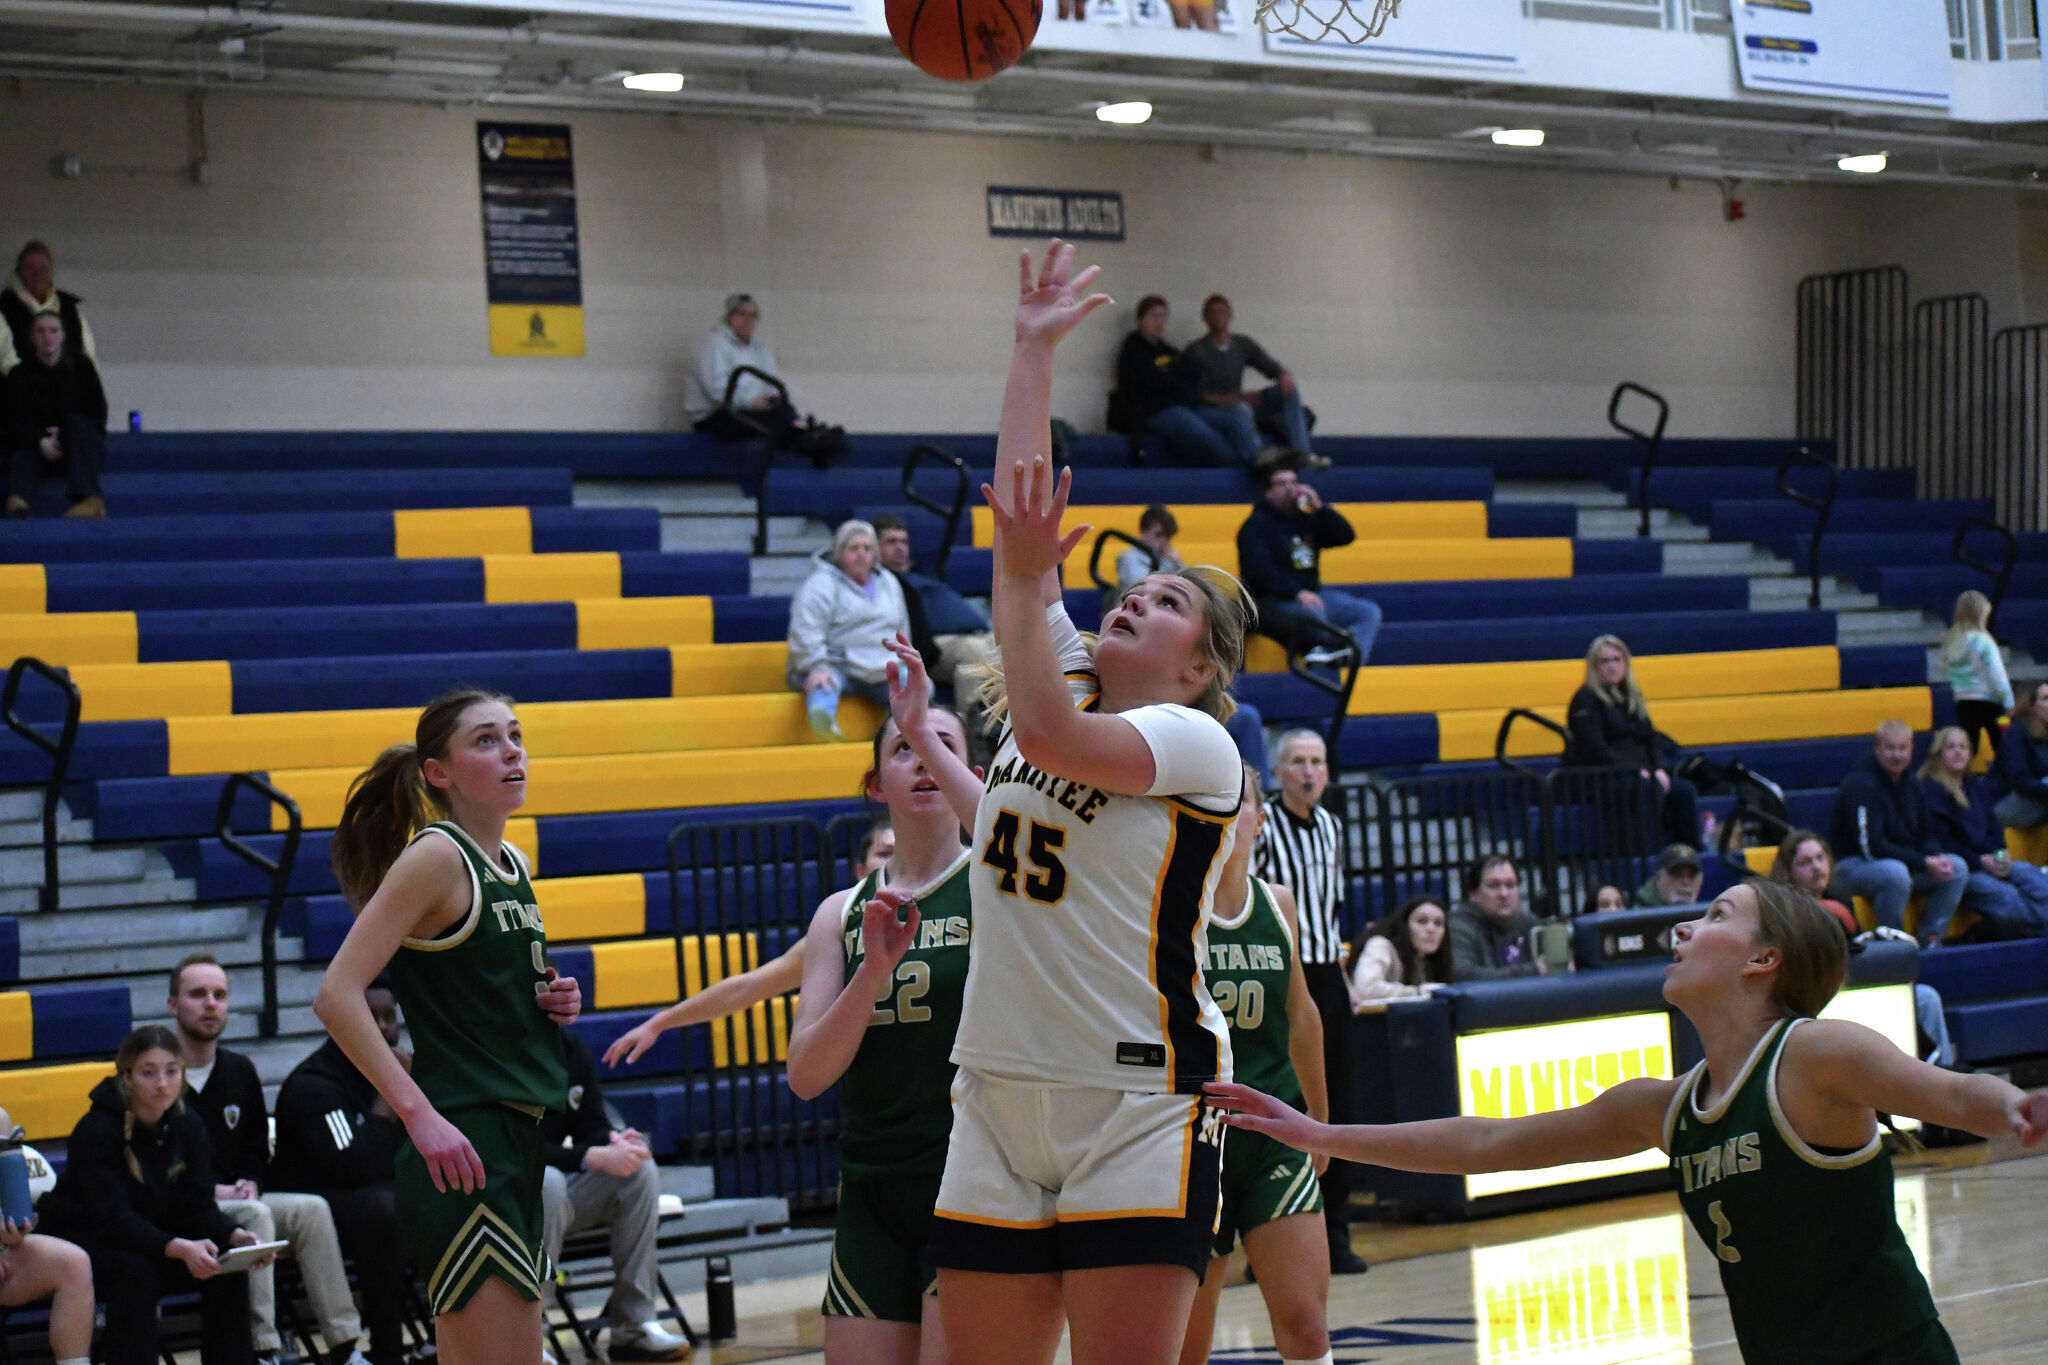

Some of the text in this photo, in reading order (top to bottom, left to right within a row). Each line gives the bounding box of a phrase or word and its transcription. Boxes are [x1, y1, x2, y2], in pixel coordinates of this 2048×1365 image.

[980, 807, 1070, 908] 45
[845, 916, 970, 963] TINS
[1202, 943, 1285, 971] ITANS
[1212, 979, 1265, 1030] 20
[1674, 1131, 1762, 1193] ITANS
